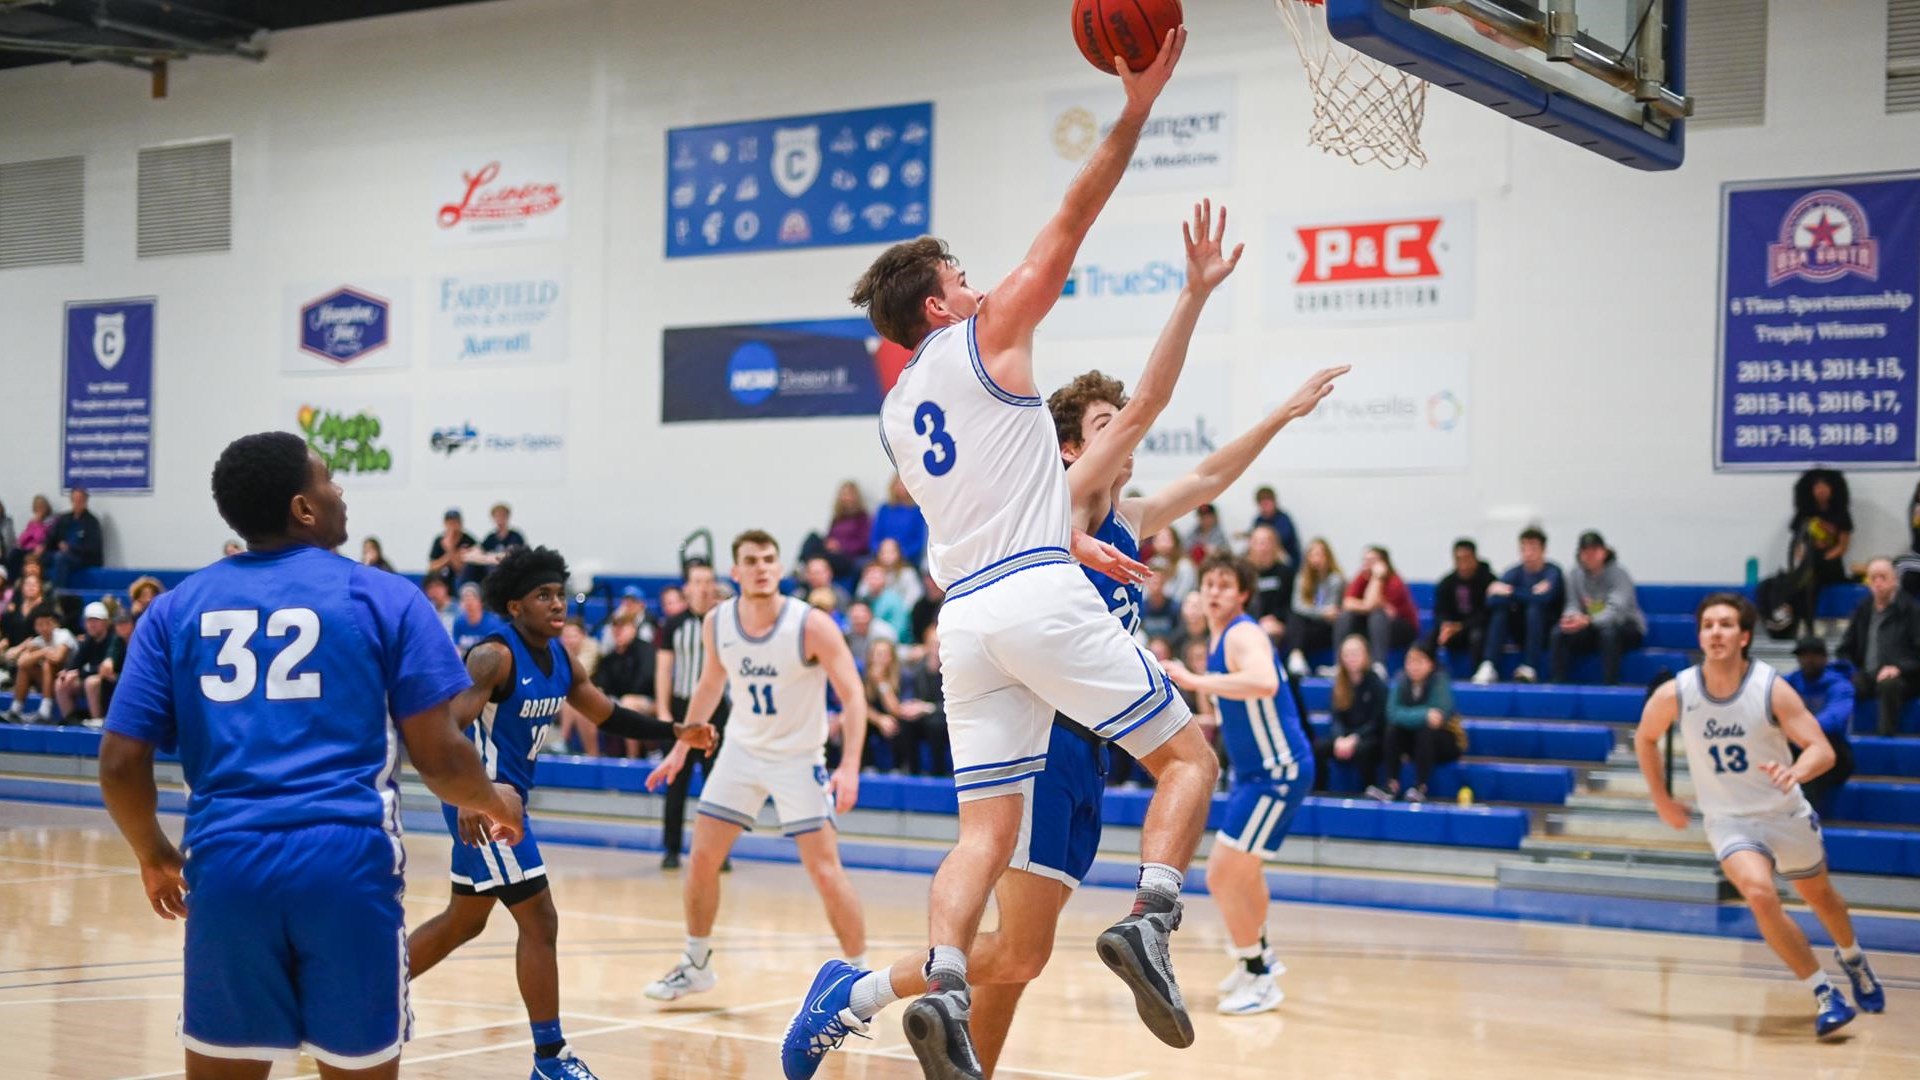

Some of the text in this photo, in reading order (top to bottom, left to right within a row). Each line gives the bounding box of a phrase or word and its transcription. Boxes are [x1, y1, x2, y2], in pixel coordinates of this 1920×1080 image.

[1295, 286, 1439, 313] CONSTRUCTION
[1787, 289, 1914, 316] Sportsmanship
[1754, 321, 1888, 346] Trophy Winners
[913, 401, 957, 476] 3
[200, 607, 321, 702] 32
[740, 656, 779, 677] Scots
[519, 695, 567, 718] BREVAR
[748, 683, 778, 715] 11
[1703, 717, 1746, 739] Scots
[1708, 744, 1749, 774] 13
